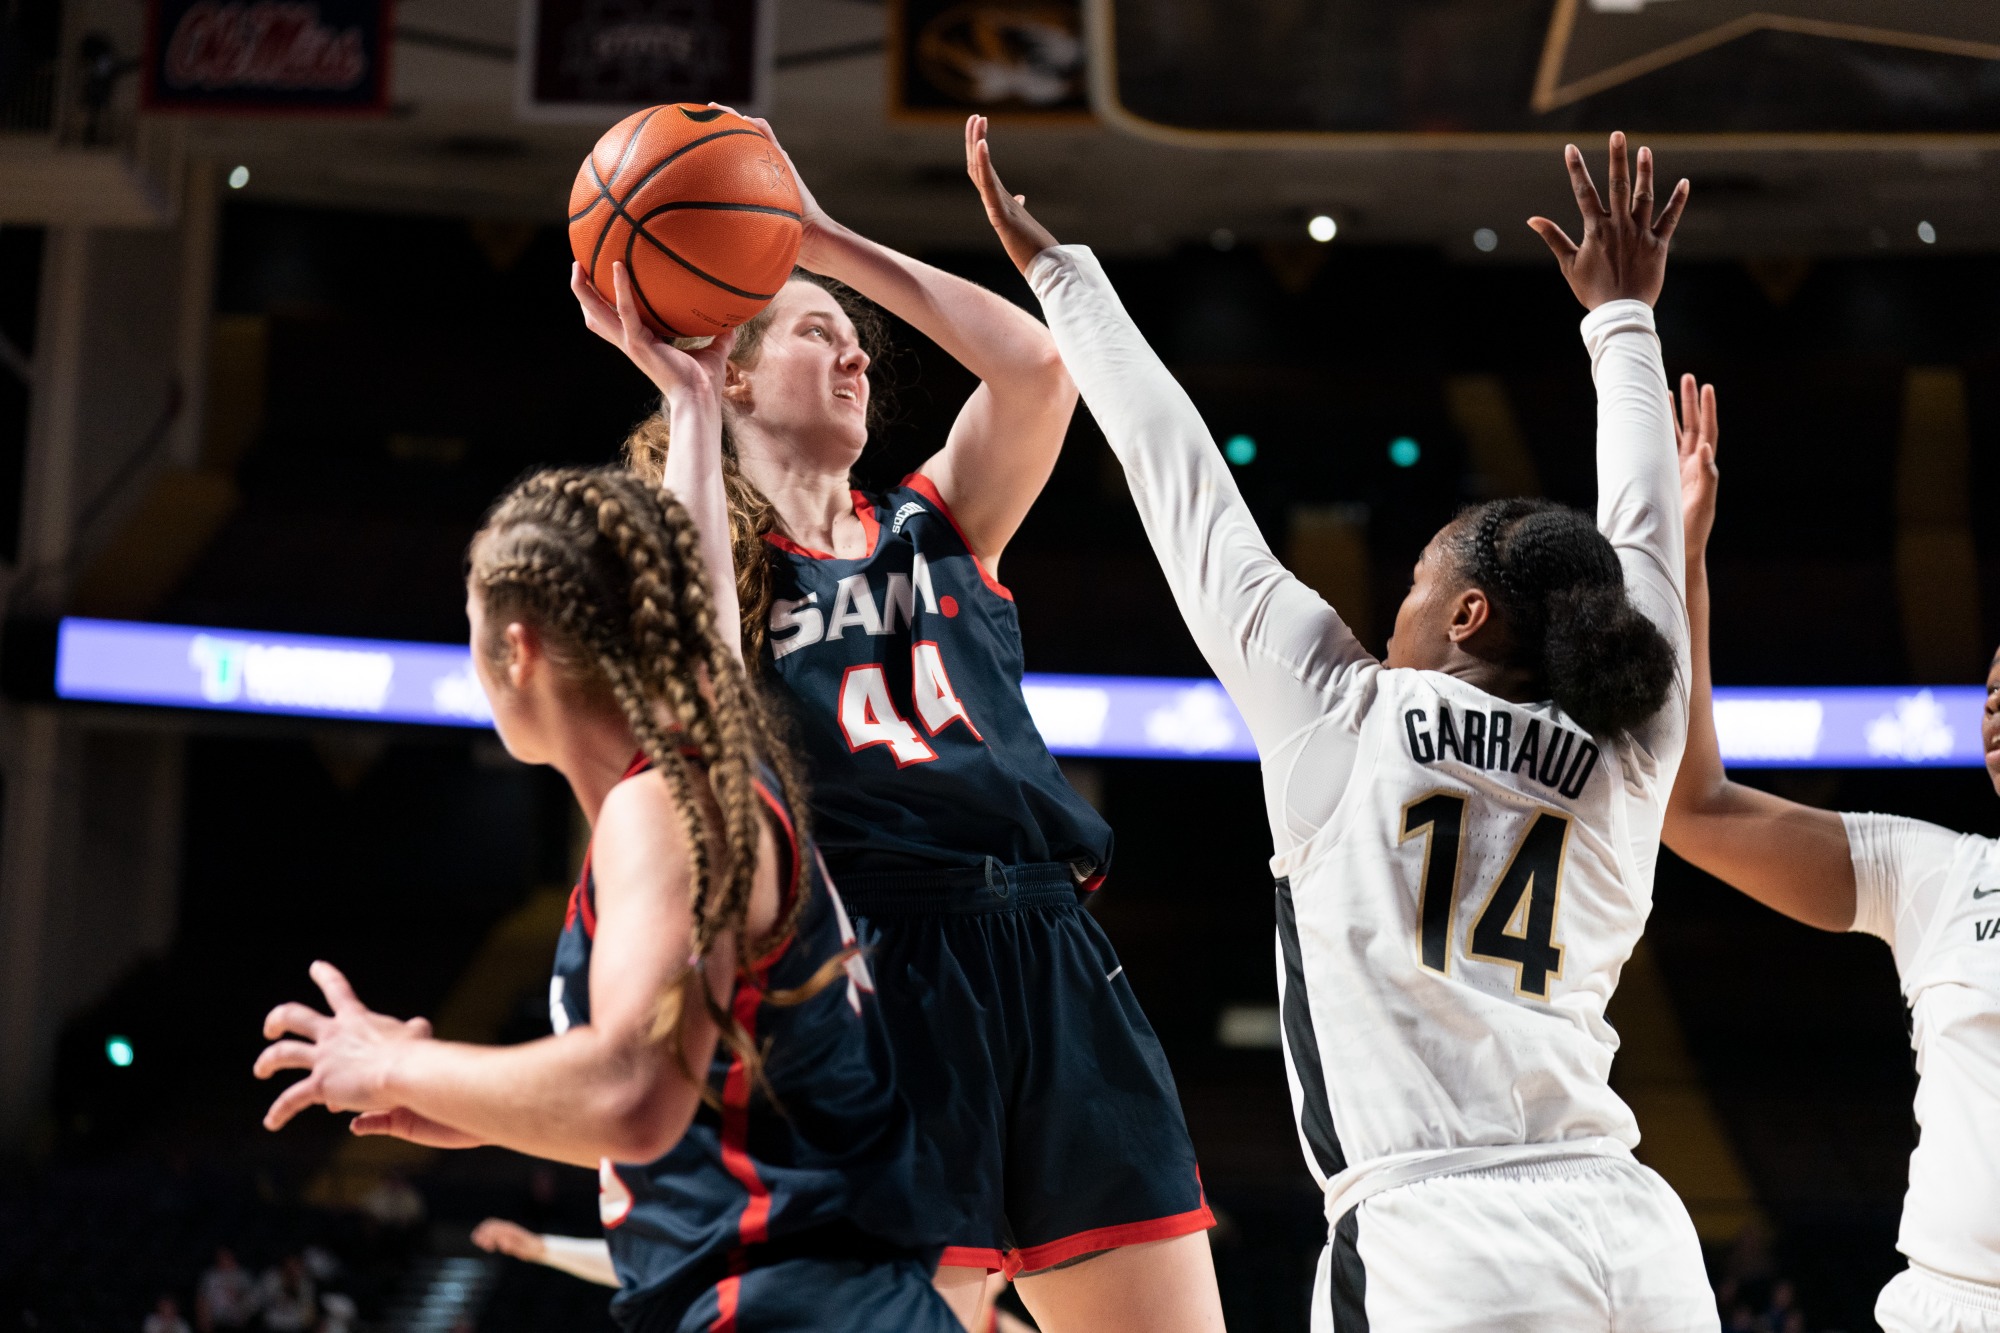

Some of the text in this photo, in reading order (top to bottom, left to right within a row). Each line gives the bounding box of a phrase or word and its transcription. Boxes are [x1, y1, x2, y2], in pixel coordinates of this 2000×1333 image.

[837, 640, 981, 769] 44
[1404, 706, 1599, 800] GARRAUD
[1398, 788, 1575, 1003] 14
